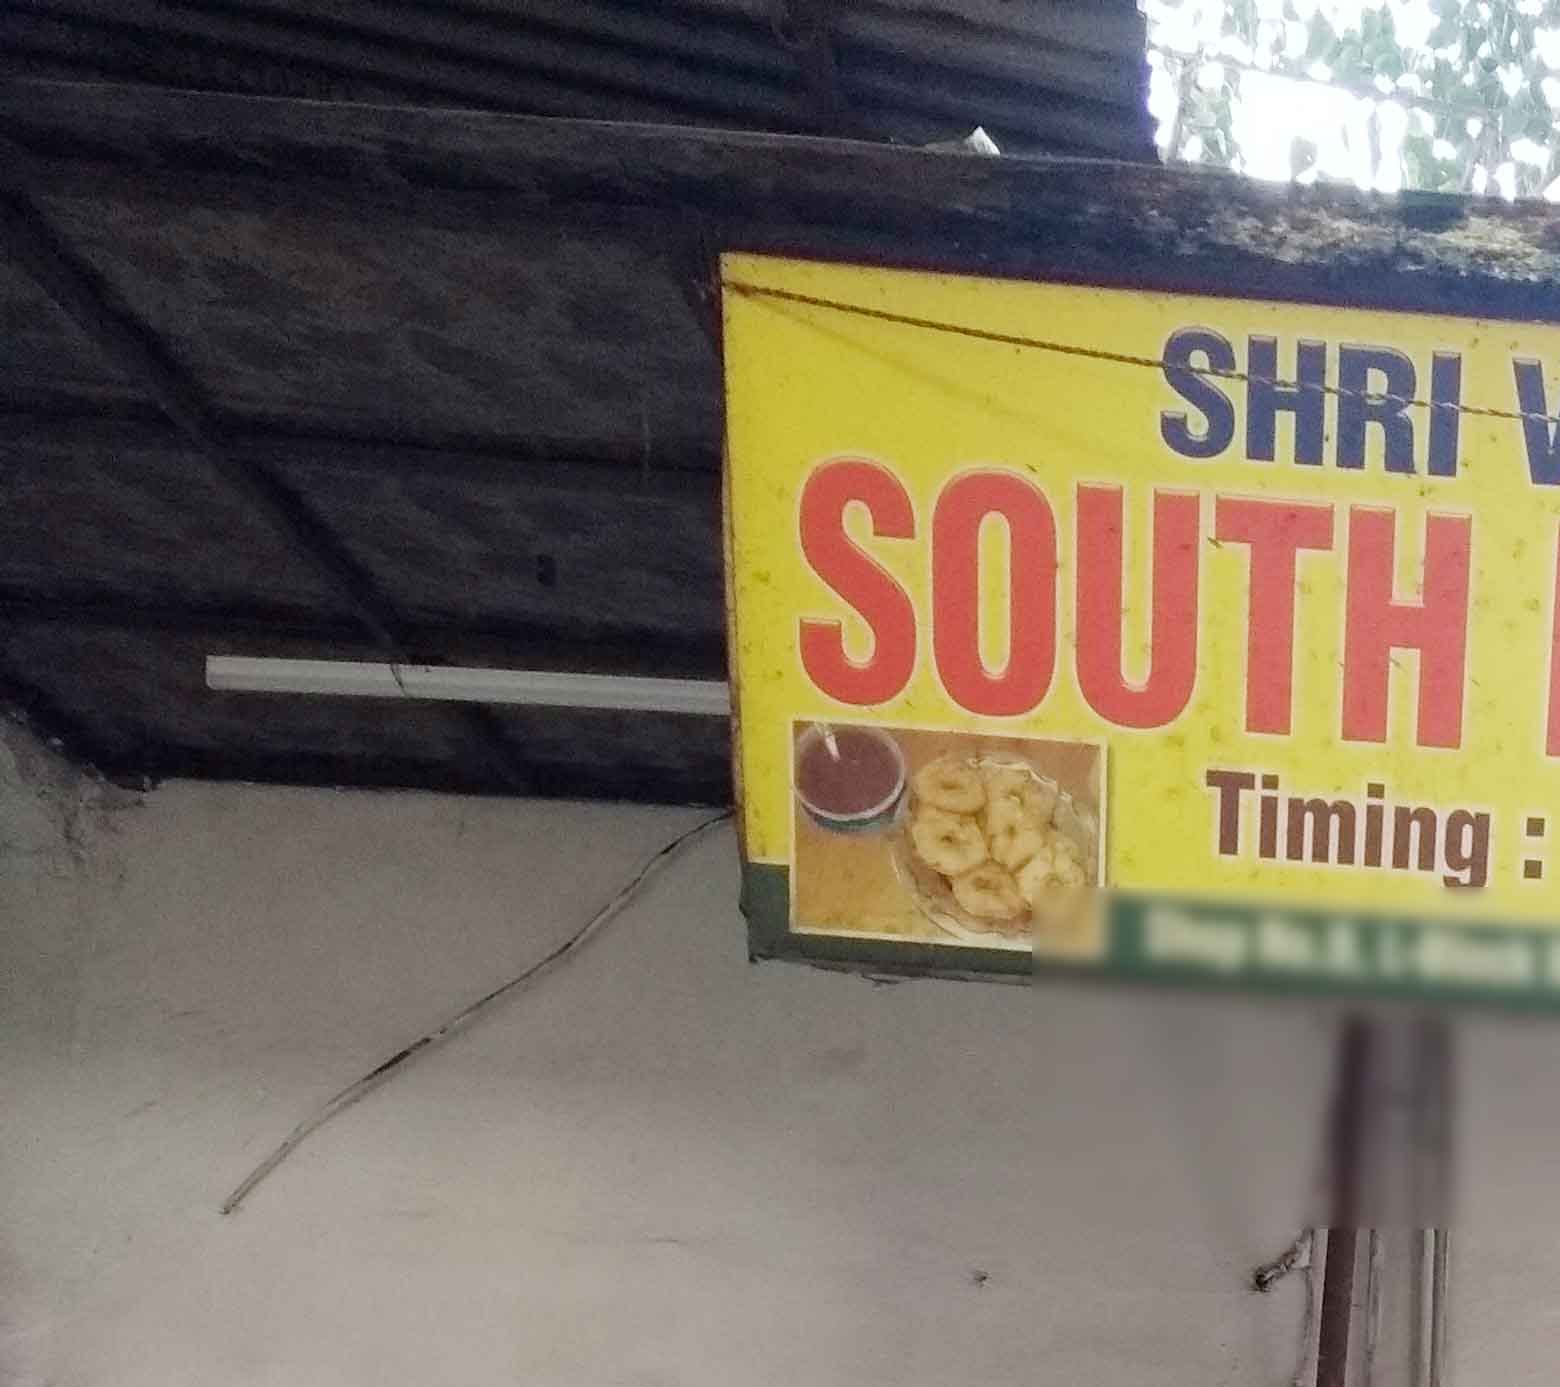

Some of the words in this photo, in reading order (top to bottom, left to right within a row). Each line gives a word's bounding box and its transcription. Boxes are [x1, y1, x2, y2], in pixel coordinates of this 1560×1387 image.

[1159, 326, 1463, 477] SHRI
[797, 455, 1474, 750] SOUTH
[1206, 769, 1492, 889] Timing
